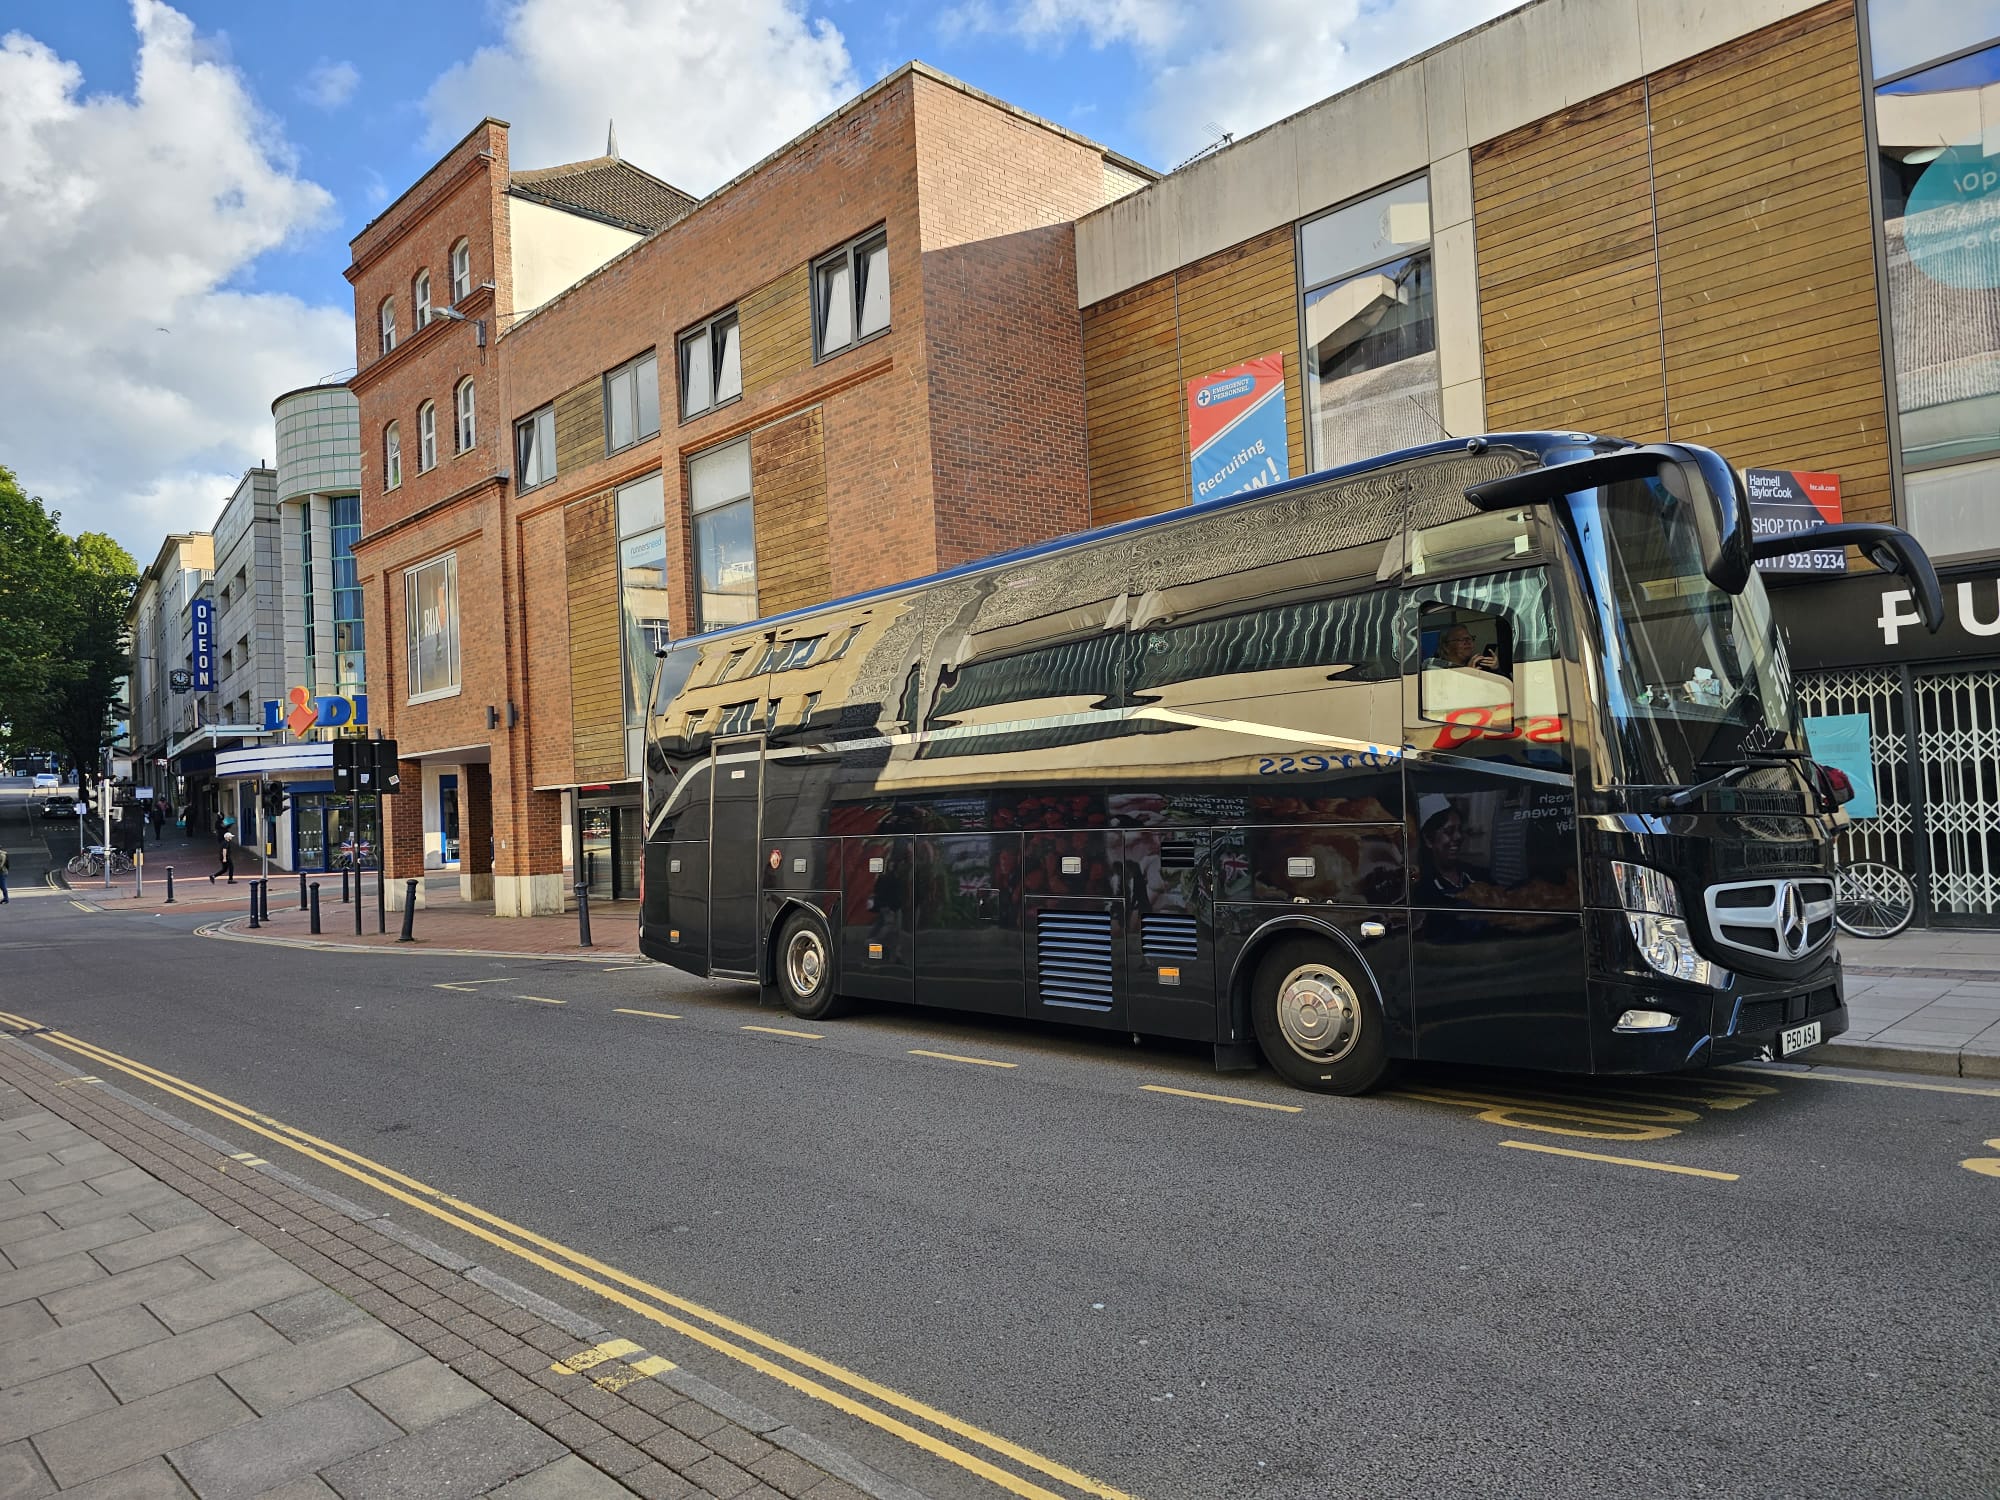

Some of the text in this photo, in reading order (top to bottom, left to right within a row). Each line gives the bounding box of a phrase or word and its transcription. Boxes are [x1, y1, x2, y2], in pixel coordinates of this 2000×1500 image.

[1212, 378, 1250, 395] EMERGENCY
[1213, 384, 1249, 401] PERSONNEL
[1197, 439, 1266, 496] Recruiting
[1749, 474, 1780, 487] Hartnell
[1751, 517, 1784, 534] SHOP
[1785, 519, 1803, 533] TO
[1787, 552, 1812, 569] 923
[1813, 553, 1845, 569] 9234
[197, 605, 209, 686] ODEON
[1786, 1024, 1817, 1052] P50 ASA
